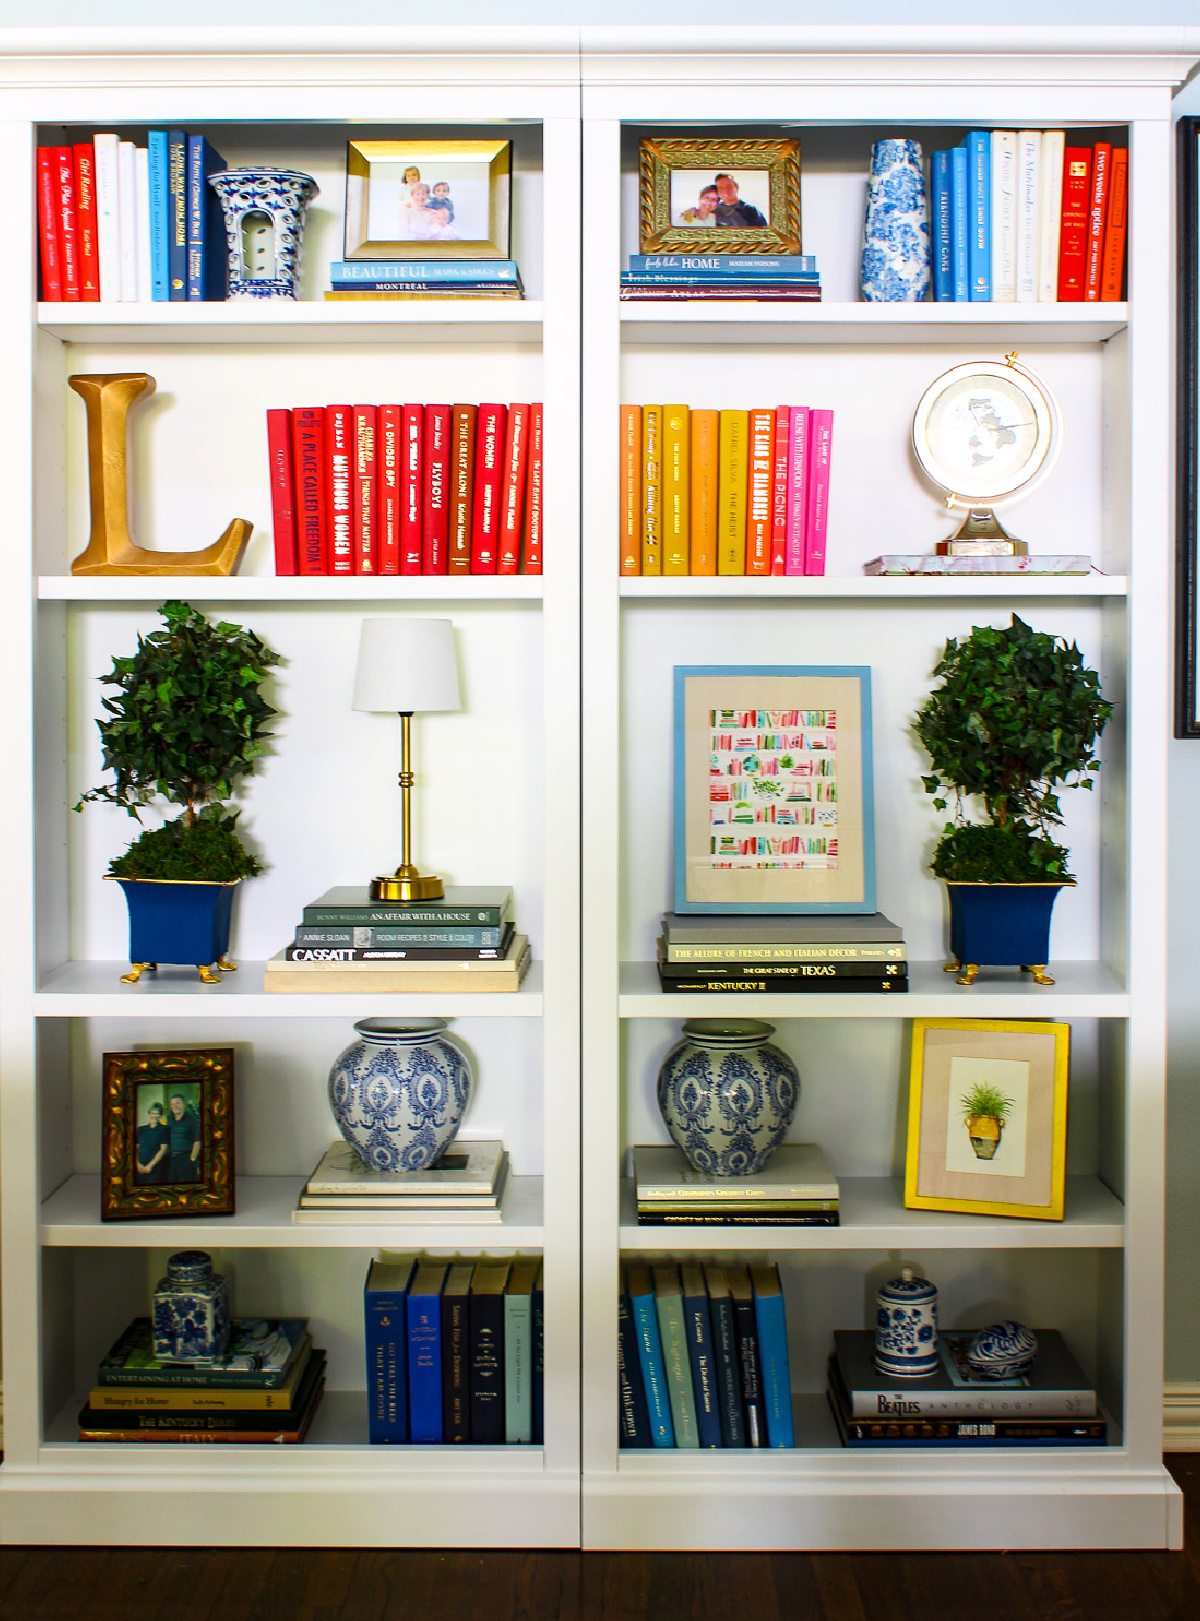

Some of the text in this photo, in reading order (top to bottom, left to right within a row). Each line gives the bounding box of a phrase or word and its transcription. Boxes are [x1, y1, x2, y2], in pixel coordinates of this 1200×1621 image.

[177, 151, 185, 174] LONG
[1097, 151, 1107, 171] two
[79, 158, 91, 210] Girl Reading
[177, 176, 185, 195] WAY
[1095, 173, 1105, 205] weeks
[177, 196, 185, 219] FROM
[941, 191, 950, 272] FRIENDSHIP CAKE
[1091, 206, 1103, 237] notice
[176, 221, 185, 247] HOME
[342, 266, 430, 278] BEAUTIFUL
[682, 258, 721, 268] HOME
[459, 422, 469, 440] THE
[486, 415, 496, 434] THE
[754, 414, 771, 432] THE
[794, 413, 804, 436] REESE
[385, 431, 395, 468] DIVIDED
[459, 441, 469, 468] GREAT
[484, 434, 495, 470] WOMEN
[754, 434, 771, 458] KING
[302, 443, 316, 473] PLACE
[793, 436, 804, 488] WITHERSPOON
[385, 469, 395, 488] SPY
[431, 462, 443, 509] FLYBOYS
[458, 469, 469, 498] ALONE
[533, 470, 541, 486] LAST
[728, 422, 739, 538] DANIEL SILVA THE HEIST
[304, 476, 318, 512] CALLED
[508, 484, 517, 508] FANNIE
[532, 487, 540, 504] DAYS
[645, 485, 658, 515] Killing
[752, 473, 769, 521] DIAMONDS
[774, 456, 787, 527] THE PICNIC
[333, 455, 350, 555] MUTINOUS WOMEN
[362, 506, 370, 524] THAT
[483, 507, 491, 534] HANNAH
[531, 510, 540, 545] DOGTOWN
[305, 515, 320, 563] FREEDOM
[362, 526, 370, 553] MATTER
[457, 525, 466, 551] Hannah
[791, 530, 801, 556] TEACUP
[370, 912, 472, 921] AN AFFAIR WITH A HOUSE
[303, 934, 326, 942] ANNIE
[327, 934, 351, 942] SLOAN
[376, 934, 396, 942] ROOM
[397, 934, 422, 942] RECIPES
[429, 934, 448, 942] STYLE
[292, 948, 358, 961] CASSATT
[675, 949, 858, 958] THE ALLURE OF FRENCH AND ITALIAN DECOR
[800, 965, 836, 976] TEXAS
[707, 982, 758, 991] KENTUCKY
[452, 1304, 461, 1327] SAVING
[639, 1308, 649, 1323] The
[453, 1328, 461, 1342] FISH
[643, 1327, 653, 1353] Island
[376, 1345, 384, 1369] THAT
[671, 1340, 684, 1382] Nightingale
[698, 1355, 706, 1367] The
[183, 1376, 207, 1384] HOME
[388, 1342, 396, 1423] GO TELL THE BEES
[453, 1355, 461, 1388] DROWNING
[700, 1367, 709, 1386] Death
[725, 1367, 733, 1392] WHERE
[376, 1378, 384, 1392] AM
[104, 1397, 133, 1406] Hungry
[376, 1394, 384, 1421] GONE
[453, 1397, 461, 1410] AMY
[622, 1386, 637, 1437] Unknown
[928, 1402, 1035, 1410] ANTHOLOGY
[138, 1415, 237, 1428] THE KENTUCKY DERBY
[453, 1412, 461, 1425] TAN
[957, 1424, 978, 1436] JAMES
[979, 1424, 996, 1436] BOND
[179, 1433, 217, 1444] ITALY
